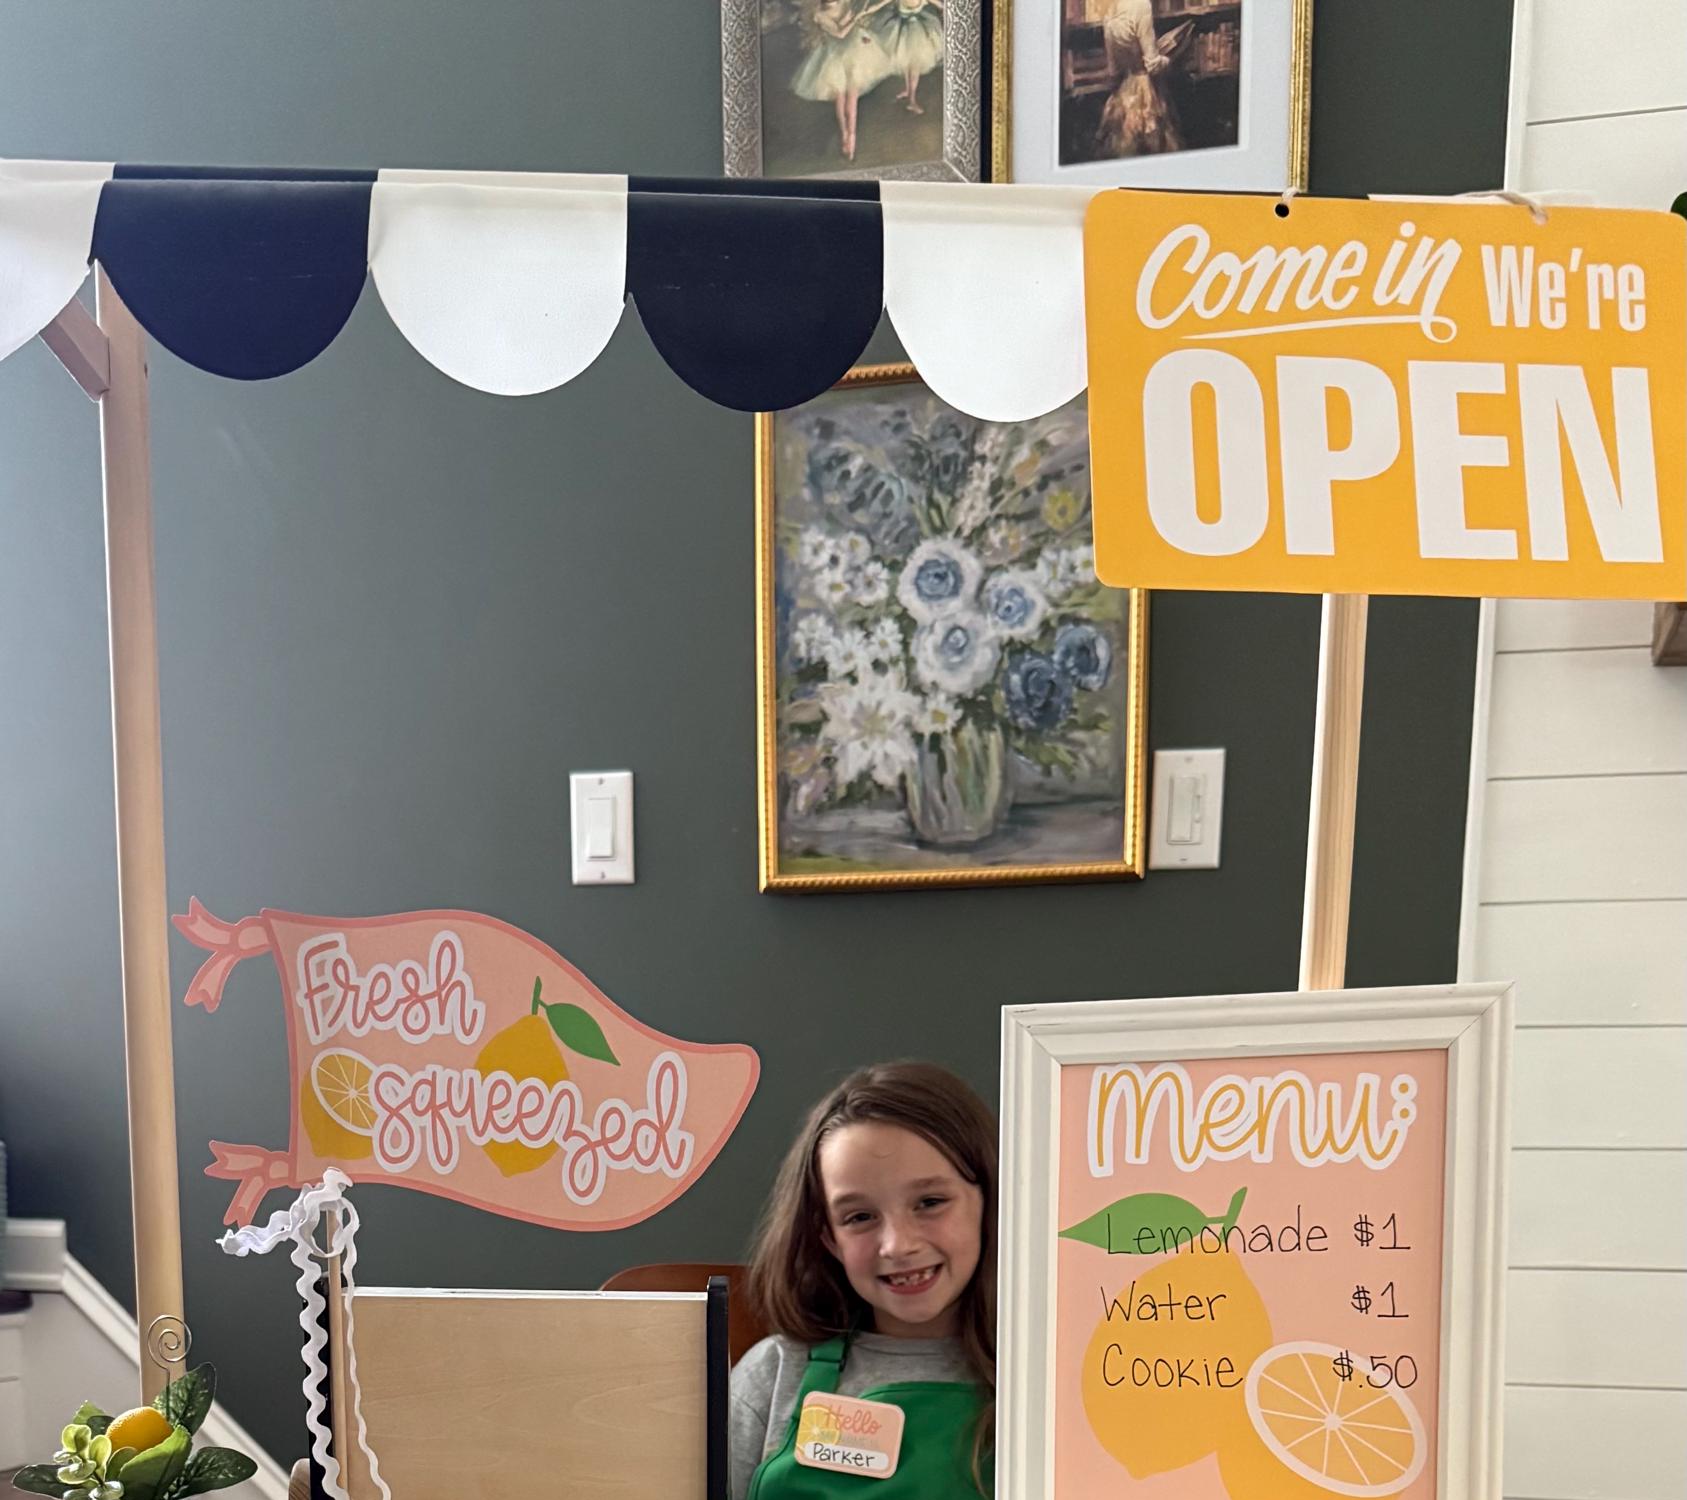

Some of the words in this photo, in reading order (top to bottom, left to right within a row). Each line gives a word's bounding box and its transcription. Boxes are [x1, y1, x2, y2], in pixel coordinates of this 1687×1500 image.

[1135, 223, 1369, 330] Come
[1374, 221, 1463, 343] in
[1481, 244, 1647, 332] We're
[1142, 348, 1665, 564] OPEN
[297, 930, 486, 1045] Fresh
[367, 1052, 694, 1206] squeezed
[1107, 1204, 1329, 1255] Lemonade
[1353, 1213, 1411, 1251] $1
[1100, 1281, 1227, 1323] Water
[1351, 1281, 1409, 1319] $1
[1101, 1343, 1244, 1389] Cookie
[1332, 1350, 1419, 1390] $.50
[825, 1404, 882, 1435] Hello
[813, 1442, 875, 1467] Parker
